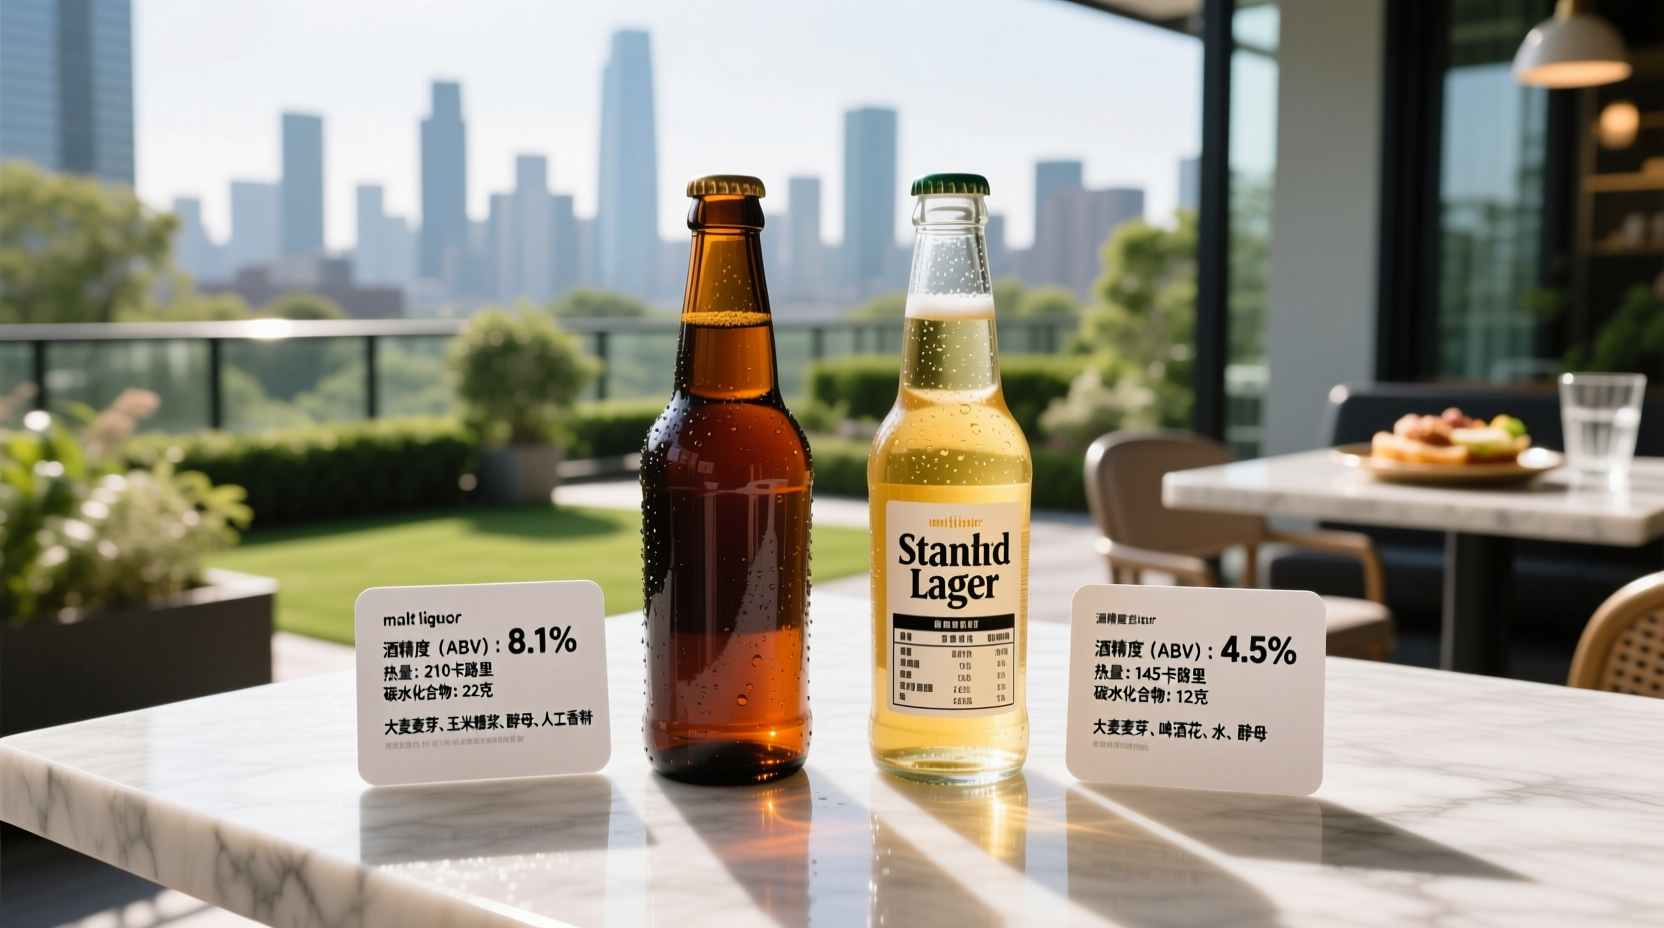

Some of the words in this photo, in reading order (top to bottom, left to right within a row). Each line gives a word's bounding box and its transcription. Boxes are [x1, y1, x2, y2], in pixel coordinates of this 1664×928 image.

[910, 568, 1000, 610] Lager
[383, 611, 416, 627] malt
[507, 625, 578, 655] 8.1%
[1220, 635, 1298, 665] 4.5%
